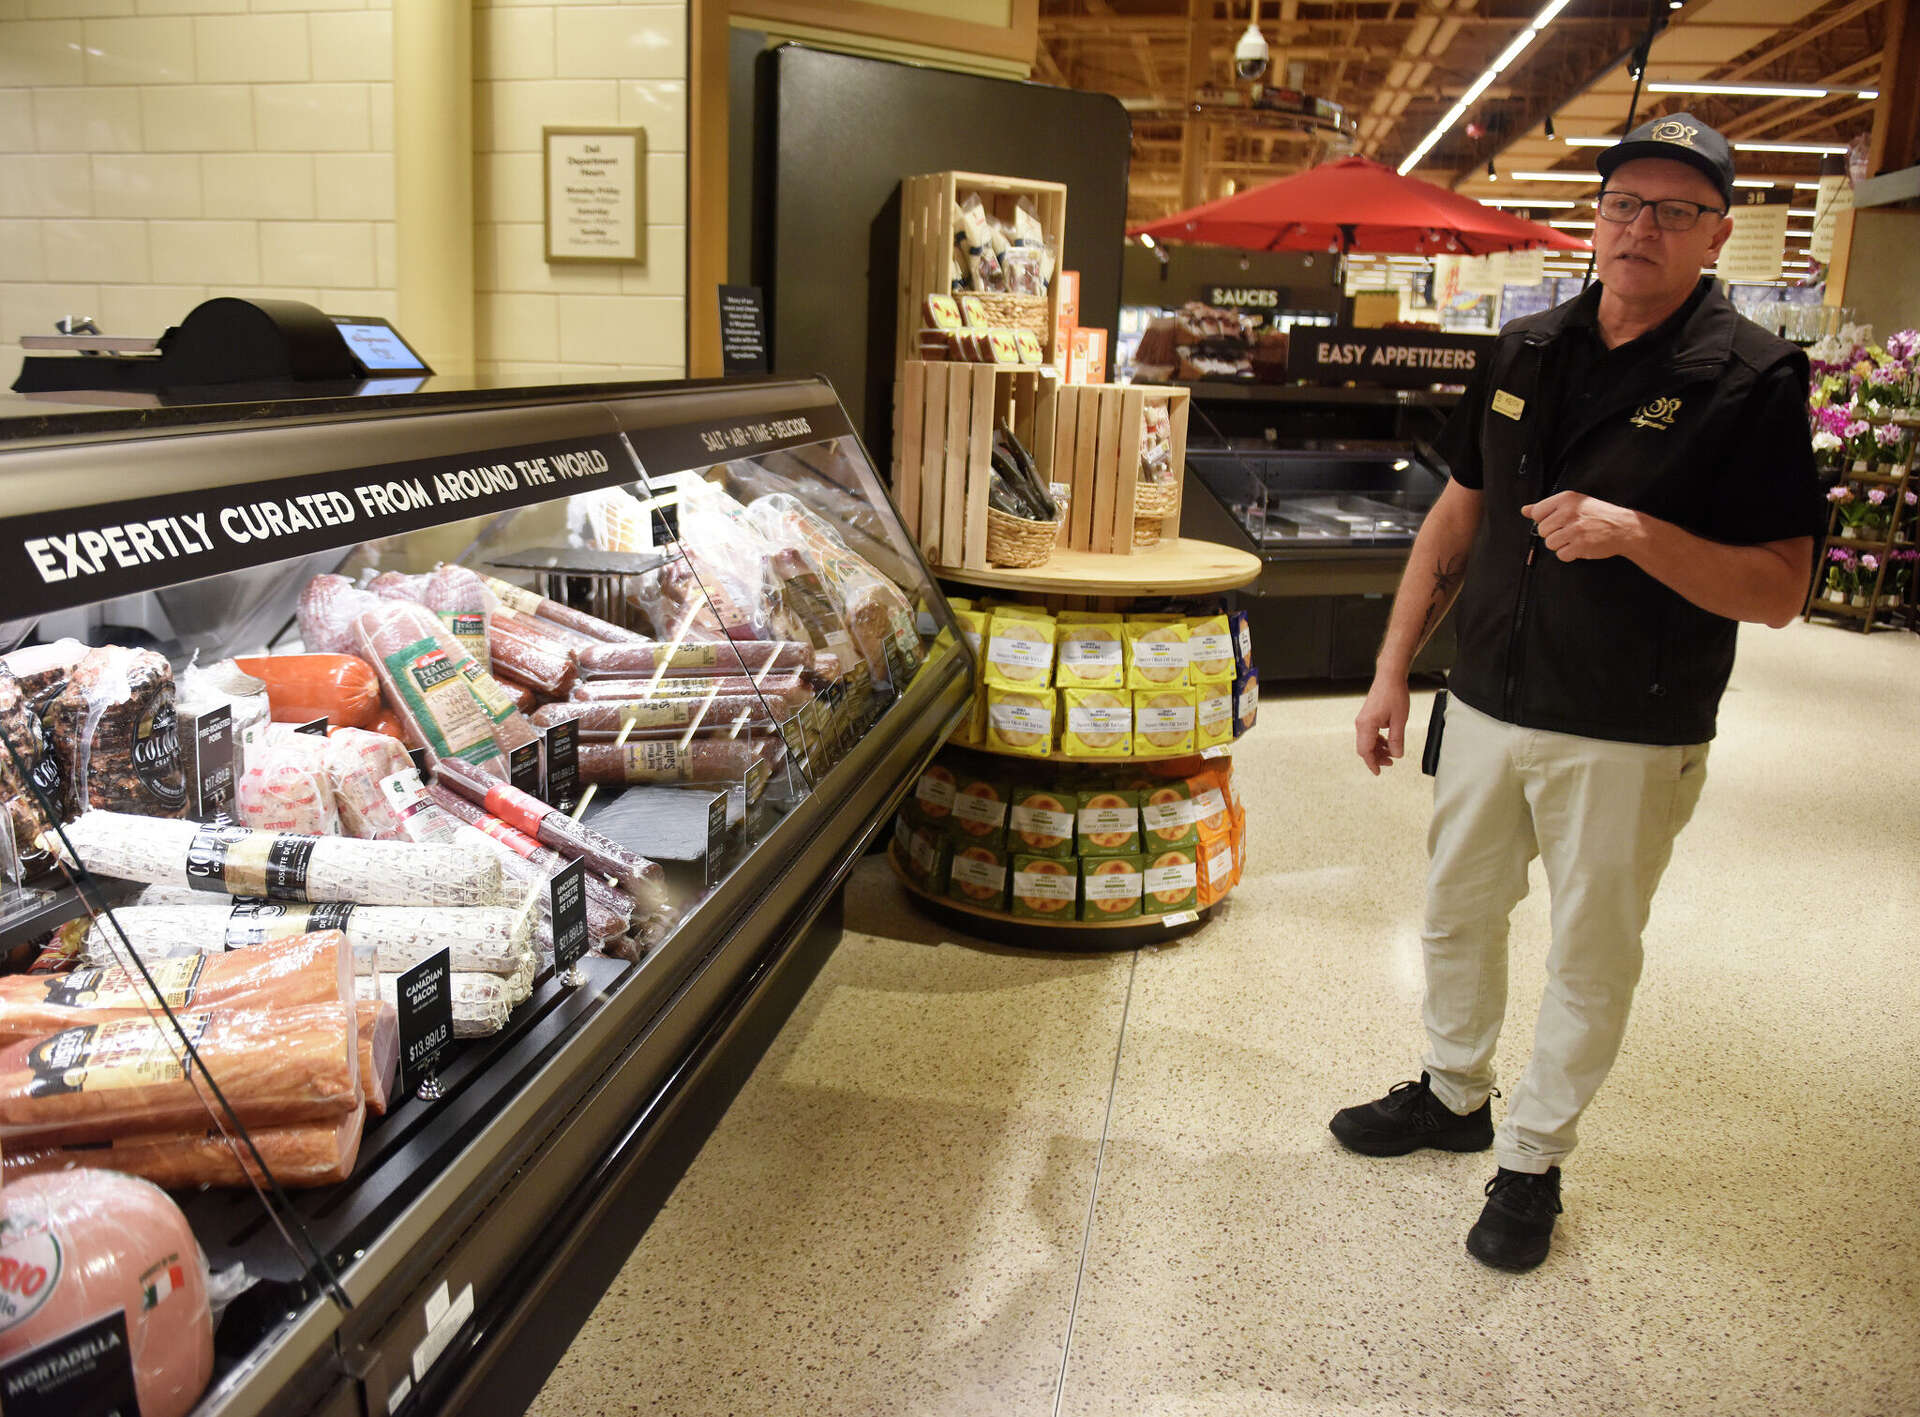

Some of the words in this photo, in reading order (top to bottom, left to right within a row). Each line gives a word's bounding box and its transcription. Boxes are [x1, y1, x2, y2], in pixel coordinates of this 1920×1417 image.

[1212, 288, 1279, 308] SAUCES
[1317, 342, 1367, 365] EASY
[1371, 345, 1477, 370] APPETIZERS
[700, 430, 727, 452] SALT
[729, 427, 749, 447] AIR
[747, 423, 772, 443] TIME
[772, 417, 812, 439] DELICIOUS
[24, 512, 215, 584] EXPERTLY
[219, 490, 357, 544] CURATED
[354, 478, 433, 521] FROM
[434, 463, 518, 503] AROUND
[516, 458, 556, 484] THE
[551, 448, 609, 480] WORLD
[406, 967, 443, 997] CANADIAN
[412, 982, 437, 1006] BACON
[409, 1024, 447, 1063] $13.99/LB
[8, 1331, 121, 1397] MORTADELLA
